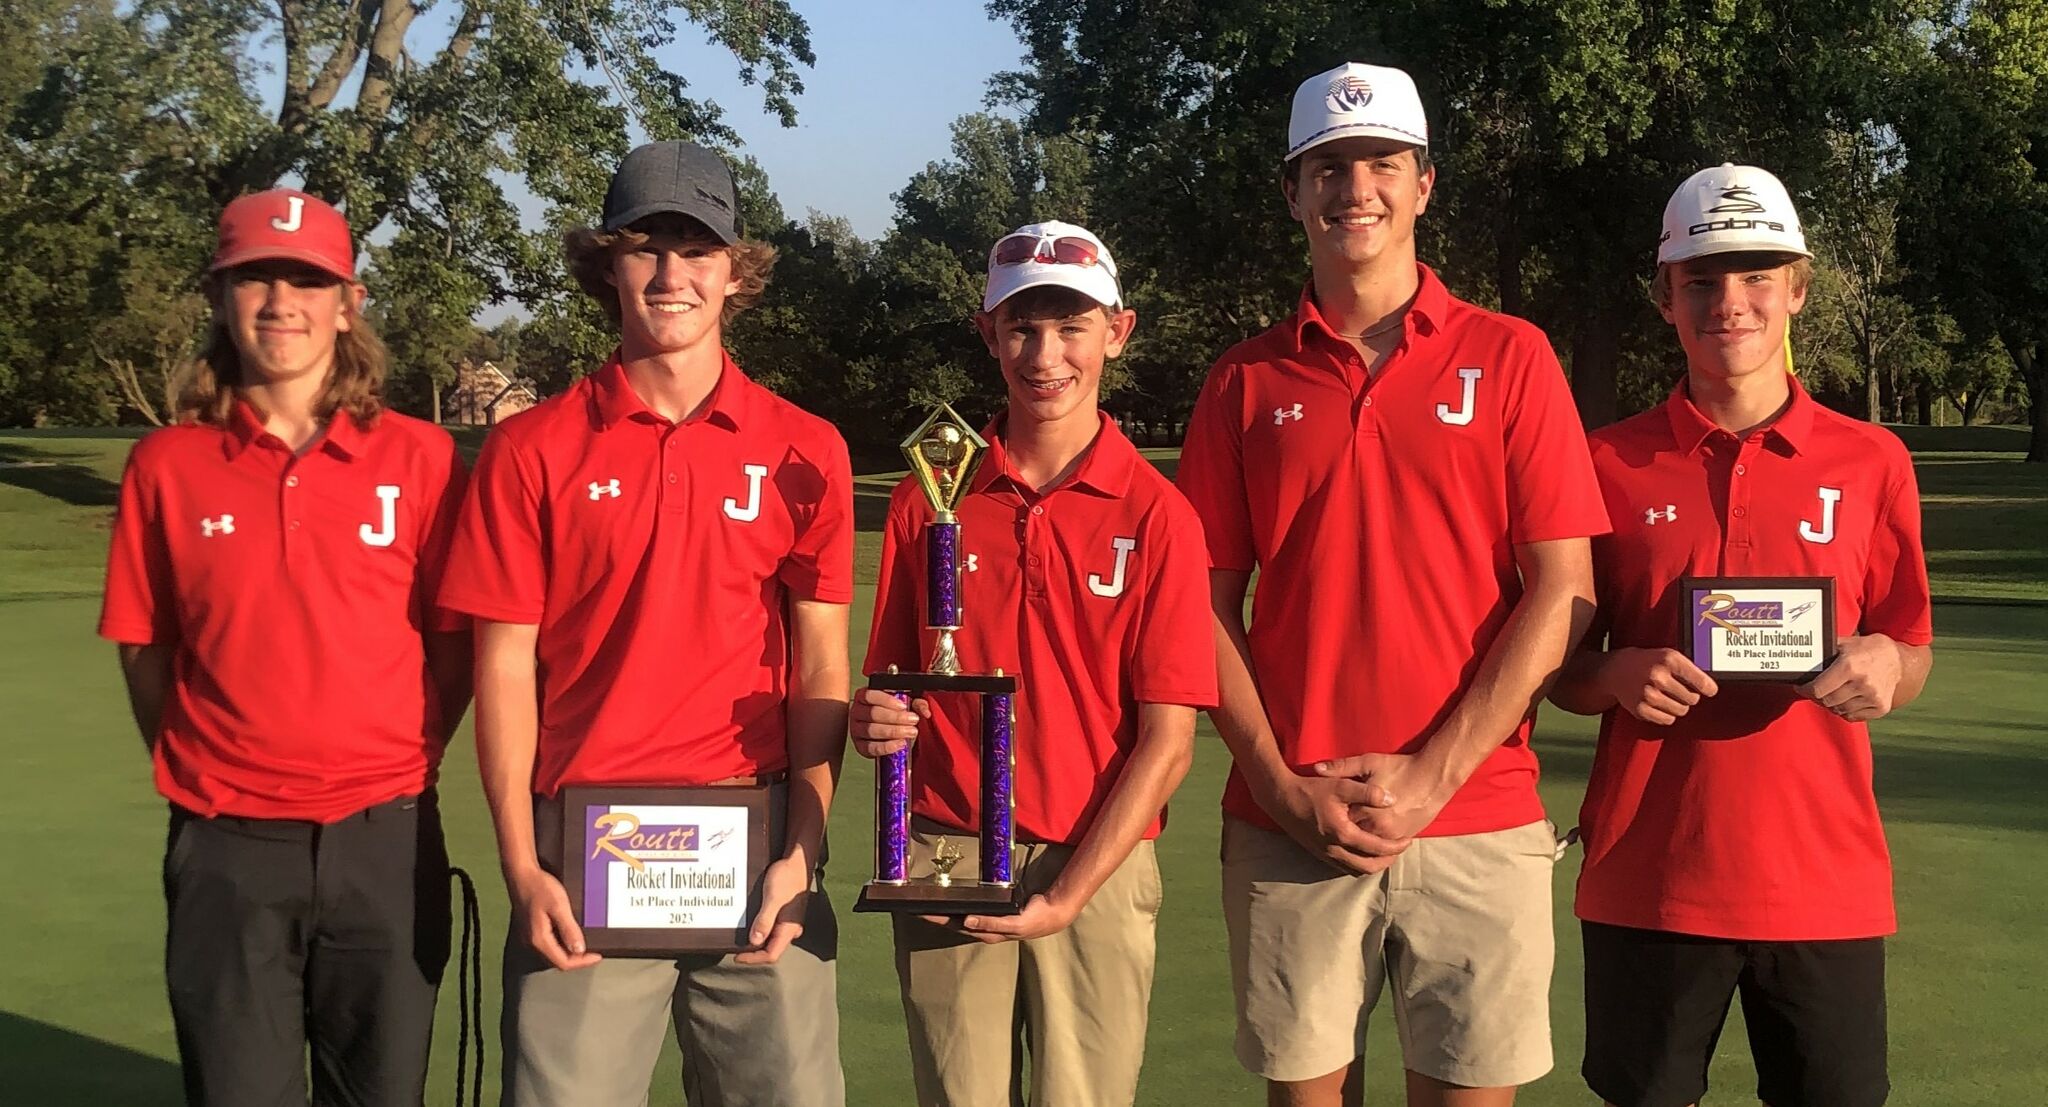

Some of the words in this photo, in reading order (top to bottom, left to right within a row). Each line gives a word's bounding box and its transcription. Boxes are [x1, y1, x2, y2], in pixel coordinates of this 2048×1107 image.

[271, 196, 304, 232] J
[1689, 217, 1785, 236] cobra
[1436, 368, 1482, 426] J
[723, 464, 768, 522] J
[358, 485, 401, 547] J
[1799, 486, 1841, 544] J
[1088, 537, 1136, 598] J
[1698, 593, 1780, 635] Routt
[1726, 630, 1757, 646] Rocket
[1760, 630, 1813, 646] Invitational
[1727, 649, 1741, 658] 4th
[1744, 649, 1766, 658] Place
[1768, 649, 1812, 658] Individual
[1760, 661, 1780, 669] 2023
[591, 812, 695, 872] Routt
[627, 866, 666, 889] Rocket
[670, 866, 736, 889] Invitational
[630, 896, 644, 906] 1st
[648, 896, 675, 906] Place
[679, 896, 734, 907] Individual
[669, 913, 694, 924] 2023
